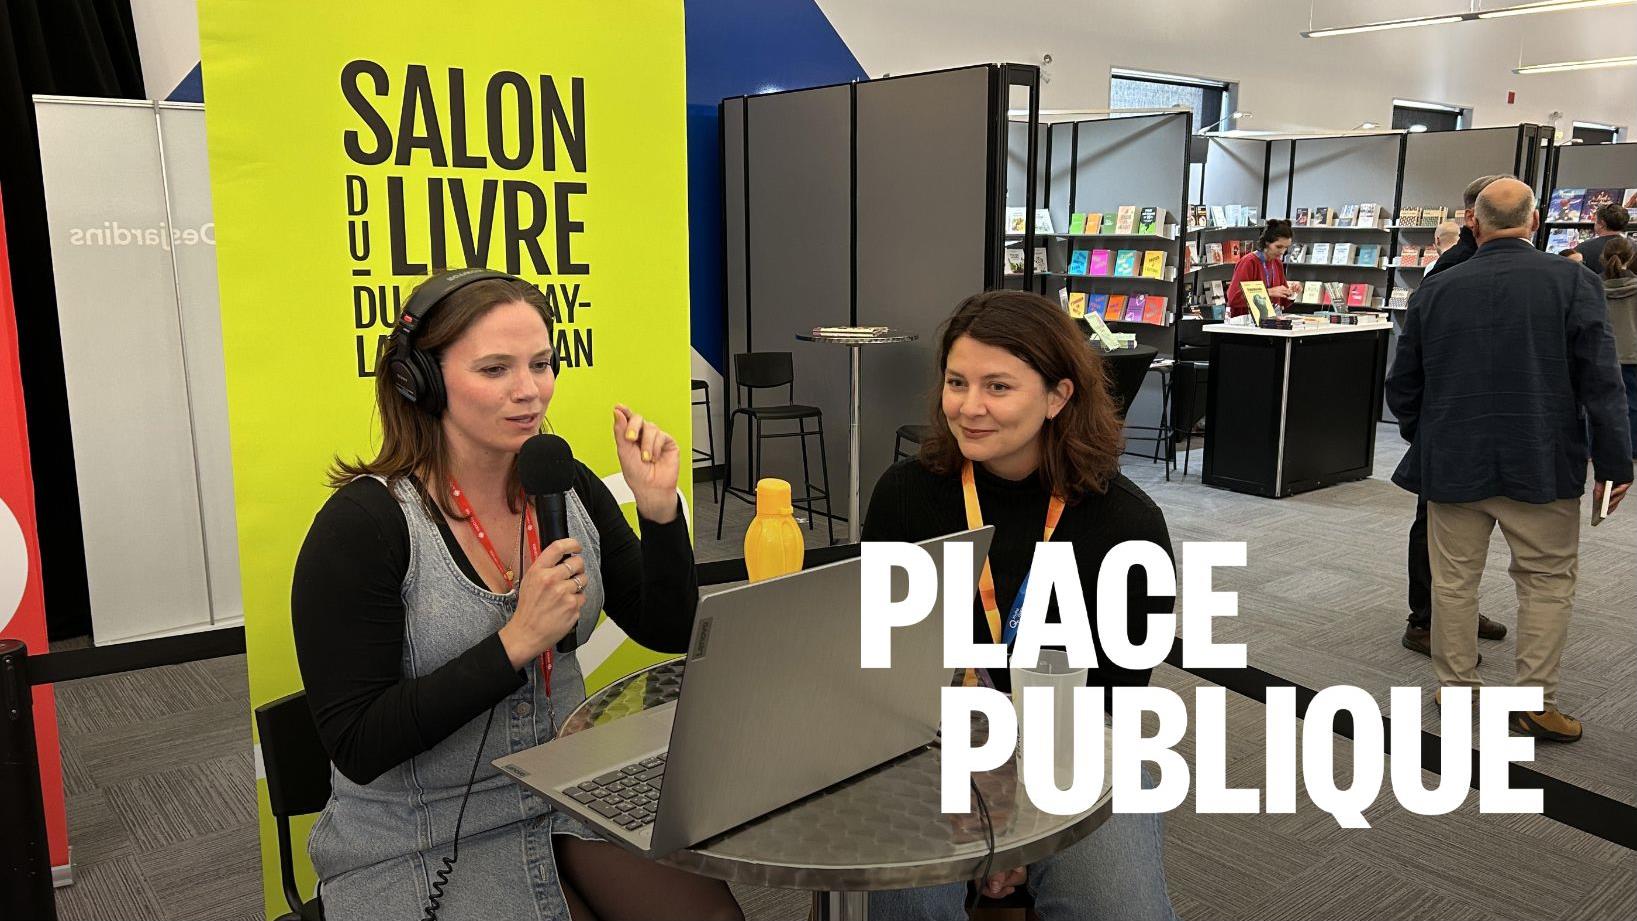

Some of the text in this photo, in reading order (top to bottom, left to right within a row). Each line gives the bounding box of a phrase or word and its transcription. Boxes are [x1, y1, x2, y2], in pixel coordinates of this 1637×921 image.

[341, 60, 587, 173] SALON
[346, 175, 590, 276] DU LIVRE
[354, 285, 401, 328] DU
